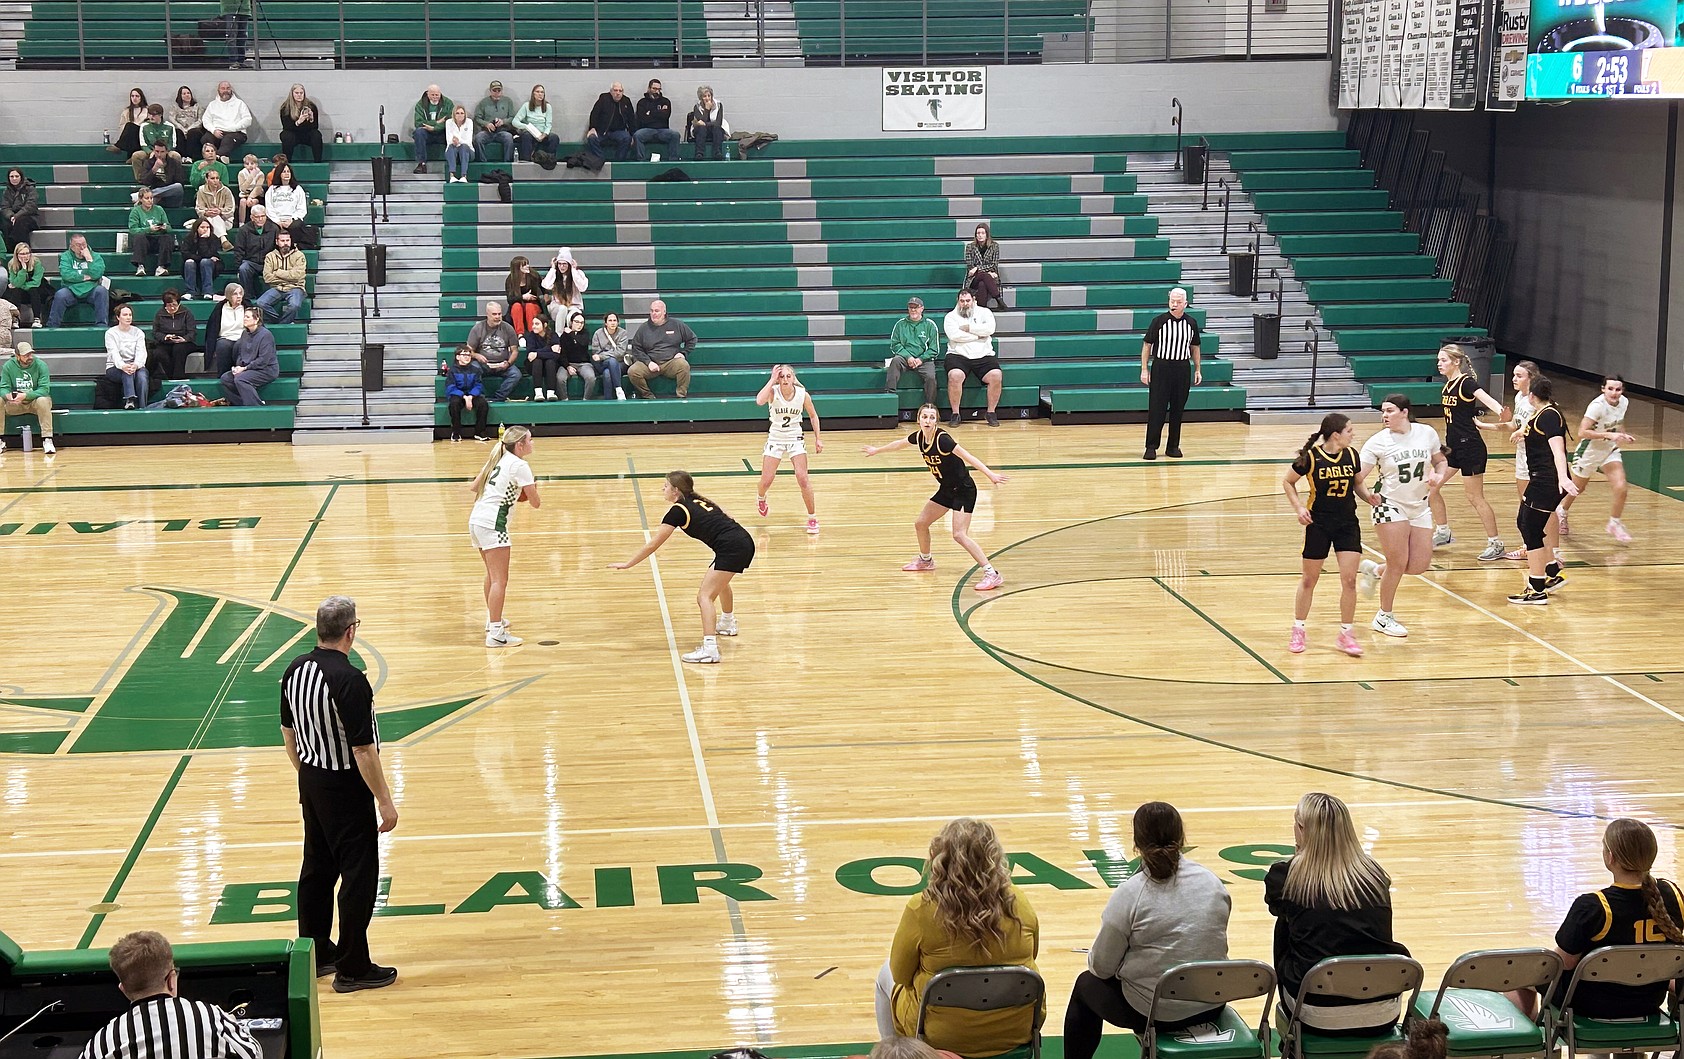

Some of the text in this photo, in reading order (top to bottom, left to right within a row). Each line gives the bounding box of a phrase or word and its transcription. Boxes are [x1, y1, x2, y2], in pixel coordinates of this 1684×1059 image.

[1503, 12, 1528, 31] Rusty
[1573, 54, 1583, 81] 6
[1596, 56, 1628, 83] 2:53
[888, 71, 982, 82] VISITOR
[886, 84, 983, 95] SEATING
[1650, 82, 1656, 94] 2
[782, 416, 791, 428] 2
[1392, 450, 1411, 462] BLAIR
[1319, 465, 1354, 479] EAGLES
[1398, 461, 1425, 483] 54
[1327, 479, 1349, 497] 23
[209, 863, 779, 925] BLAIR
